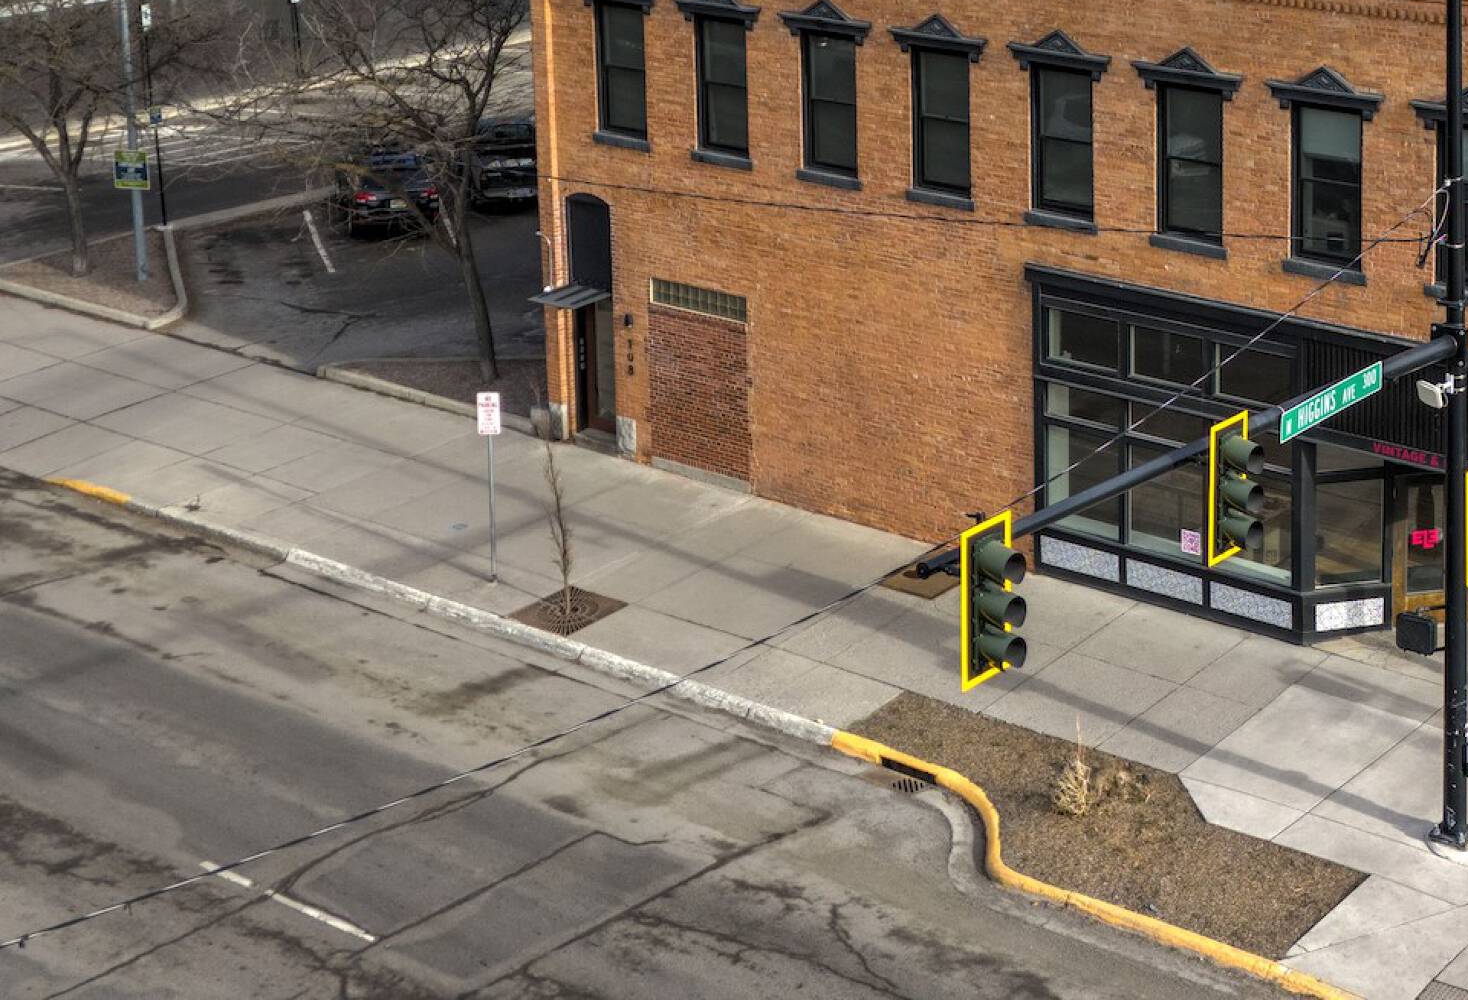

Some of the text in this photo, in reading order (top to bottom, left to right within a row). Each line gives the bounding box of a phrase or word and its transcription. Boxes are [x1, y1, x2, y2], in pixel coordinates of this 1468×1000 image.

[1298, 390, 1336, 429] HIGGINS
[1342, 384, 1356, 404] AVE
[1363, 369, 1377, 389] 300
[1373, 442, 1426, 465] VINTAGE
